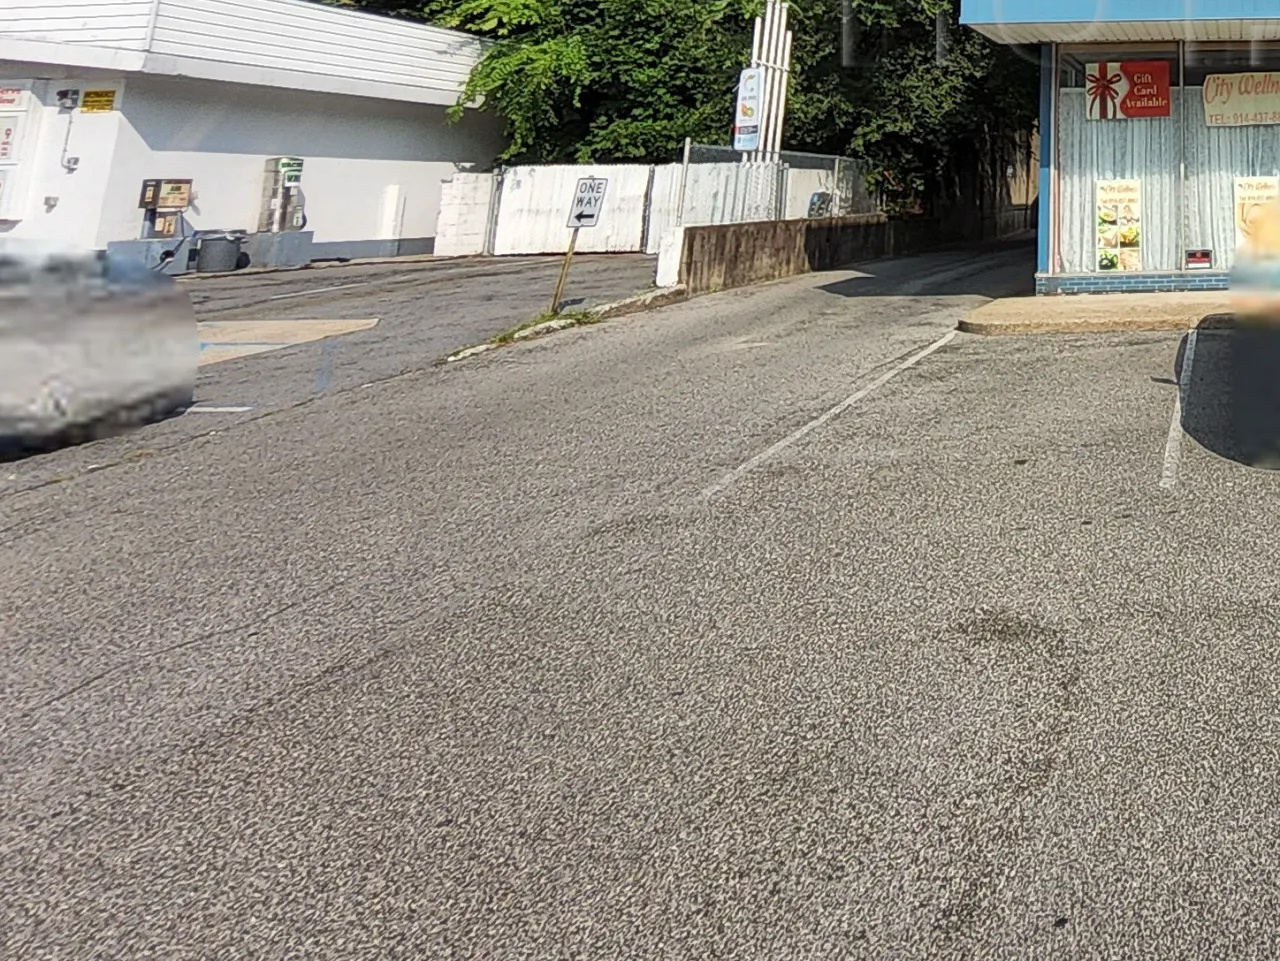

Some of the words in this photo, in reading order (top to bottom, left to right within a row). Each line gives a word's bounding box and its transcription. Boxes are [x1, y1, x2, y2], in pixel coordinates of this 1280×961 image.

[1133, 73, 1152, 84] Gift
[1133, 85, 1158, 95] Card
[1204, 76, 1234, 104] City
[1124, 96, 1168, 109] Available
[1209, 113, 1230, 125] TEL:
[579, 182, 603, 194] ONE
[576, 196, 601, 208] WAY
